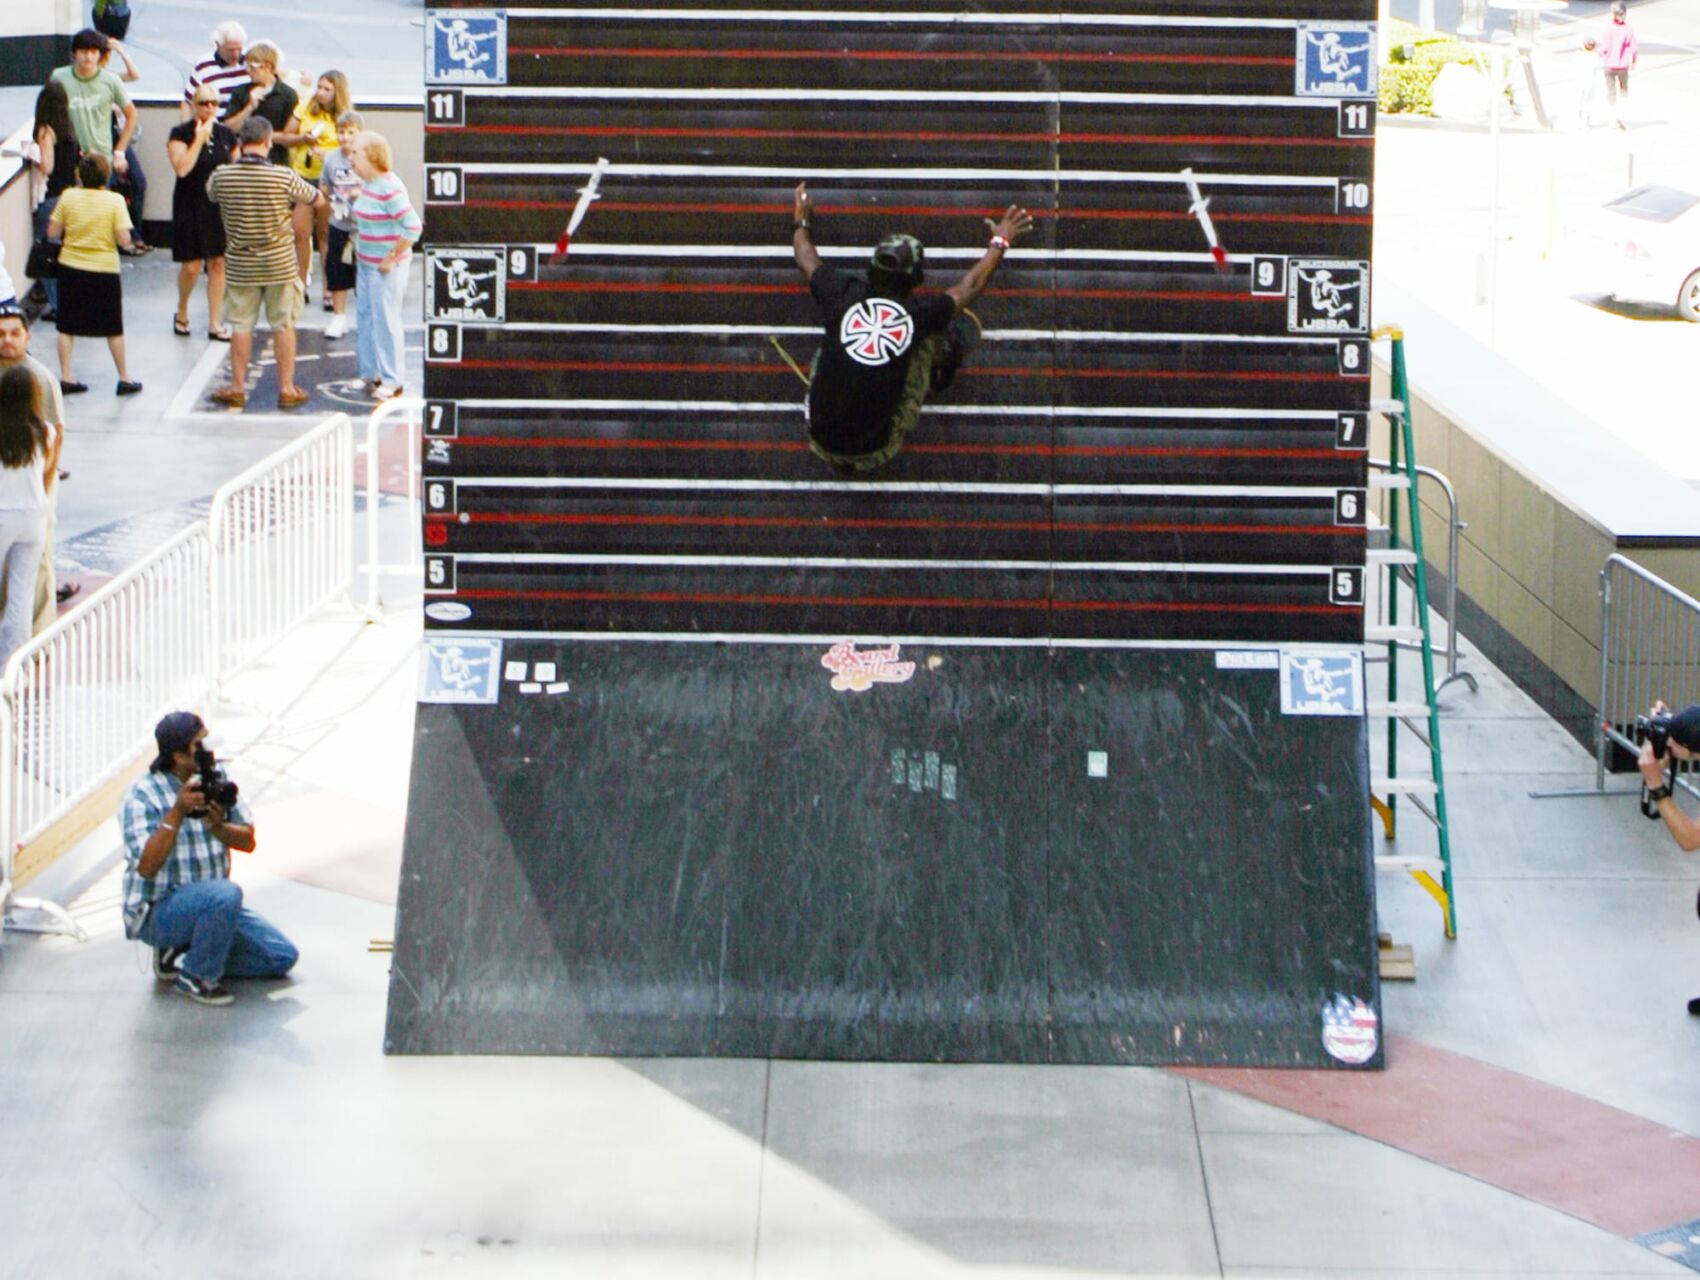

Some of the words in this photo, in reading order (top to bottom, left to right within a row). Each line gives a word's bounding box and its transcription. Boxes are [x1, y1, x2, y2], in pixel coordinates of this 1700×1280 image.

[430, 93, 454, 119] 11
[1344, 105, 1368, 129] 11
[430, 171, 457, 197] 10
[1342, 183, 1369, 209] 10
[510, 249, 527, 275] 9
[1258, 261, 1274, 287] 9
[433, 328, 449, 353] 8
[1343, 343, 1359, 370] 8
[430, 405, 444, 430] 7
[1341, 417, 1355, 442] 7
[429, 483, 446, 509] 6
[1341, 493, 1358, 518] 6
[429, 559, 445, 585] 5
[1337, 572, 1353, 597] 5
